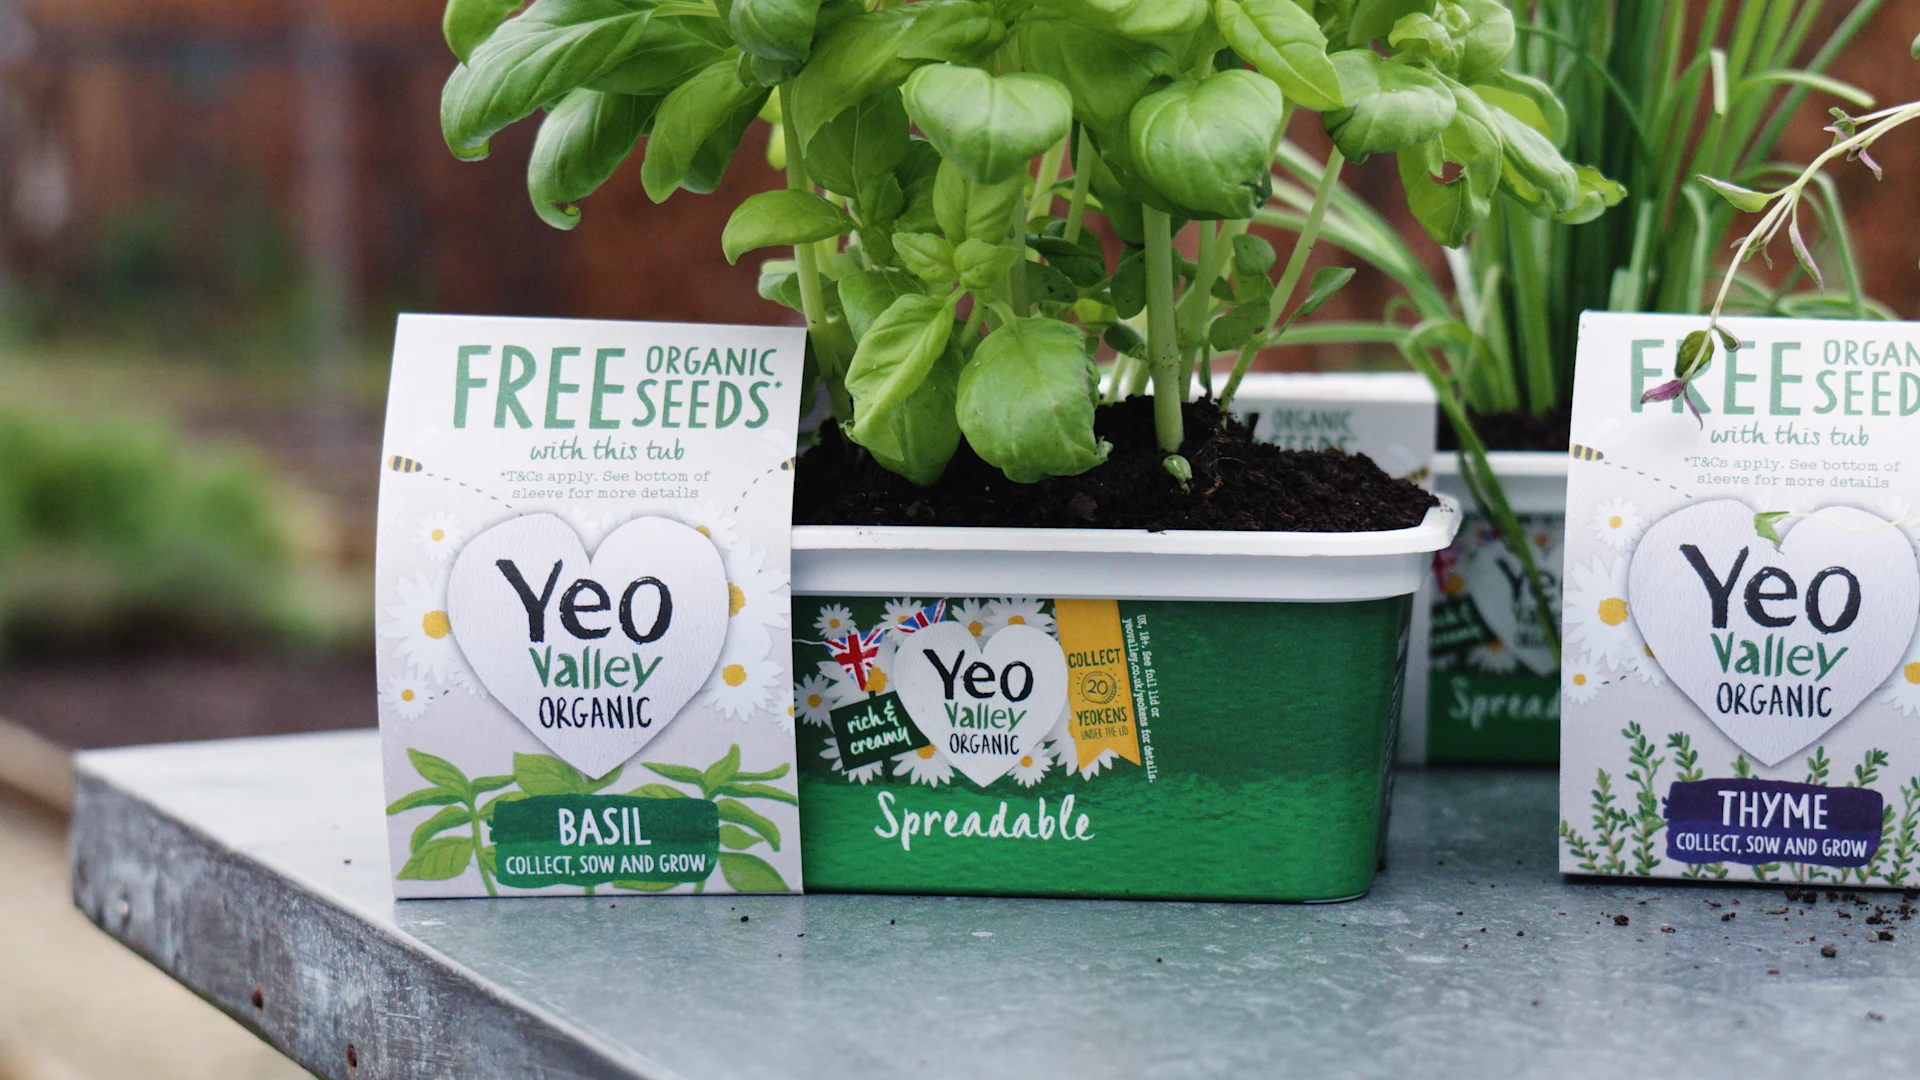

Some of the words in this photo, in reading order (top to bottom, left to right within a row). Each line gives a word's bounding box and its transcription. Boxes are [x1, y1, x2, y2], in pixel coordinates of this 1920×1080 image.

[646, 345, 777, 376] ORGANIC
[1823, 339, 1920, 367] ORGAN
[453, 344, 626, 430] FREE
[1812, 369, 1920, 417] SEED
[530, 435, 588, 461] with
[593, 437, 637, 461] this
[647, 438, 685, 461] tub
[1710, 421, 1770, 446] with
[1775, 422, 1820, 446] this
[1830, 425, 1870, 448] tub
[547, 470, 598, 486] apply.
[603, 470, 629, 483] See
[635, 470, 688, 483] bottom
[694, 470, 711, 483] of
[1732, 457, 1785, 473] apply.
[1789, 459, 1817, 471] See
[1821, 460, 1877, 472] bottom
[1884, 460, 1902, 472] of
[512, 486, 565, 500] sleeve
[568, 486, 594, 500] for
[598, 489, 637, 500] more
[641, 486, 699, 500] details
[1696, 472, 1750, 486] sleeve
[1754, 473, 1781, 486] for
[1785, 476, 1825, 487] more
[1829, 475, 1889, 489] details
[495, 559, 673, 645] Yeo
[1679, 543, 1862, 635] Yeo
[1136, 614, 1147, 629] UK,
[1138, 631, 1150, 648] 18+.
[528, 645, 664, 692] Valley
[1068, 648, 1121, 668] COLLECT
[1141, 650, 1153, 667] See
[1710, 631, 1849, 682] Valley
[923, 649, 1034, 703] Yeo
[1122, 618, 1148, 727] yeovalley.co.uk/yeokens
[1144, 668, 1157, 688] foil
[1087, 679, 1109, 695] 20
[1147, 690, 1160, 705] lid
[1716, 682, 1833, 718] ORGANIC
[538, 695, 652, 729] ORGANIC
[847, 704, 883, 734] rich
[885, 700, 900, 726] &
[944, 701, 1027, 732] Valley
[1076, 707, 1128, 727] YEOKENS
[1151, 707, 1161, 718] or
[850, 727, 912, 756] creamy
[949, 733, 1020, 756] ORGANIC
[1081, 727, 1102, 740] UNDER
[1105, 726, 1118, 738] THE
[1141, 729, 1152, 743] for
[1143, 745, 1158, 783] details.
[874, 790, 1095, 851] Spreadable
[1717, 790, 1828, 830] THYME
[557, 807, 651, 846] BASIL
[1676, 832, 1742, 855] COLLECT,
[1746, 834, 1783, 854] SOW
[1784, 837, 1817, 856] AND
[1822, 838, 1867, 858] GROW
[505, 855, 576, 876] COLLECT,
[580, 854, 615, 875] SOW
[617, 854, 654, 874] AND
[659, 853, 706, 873] GROW
